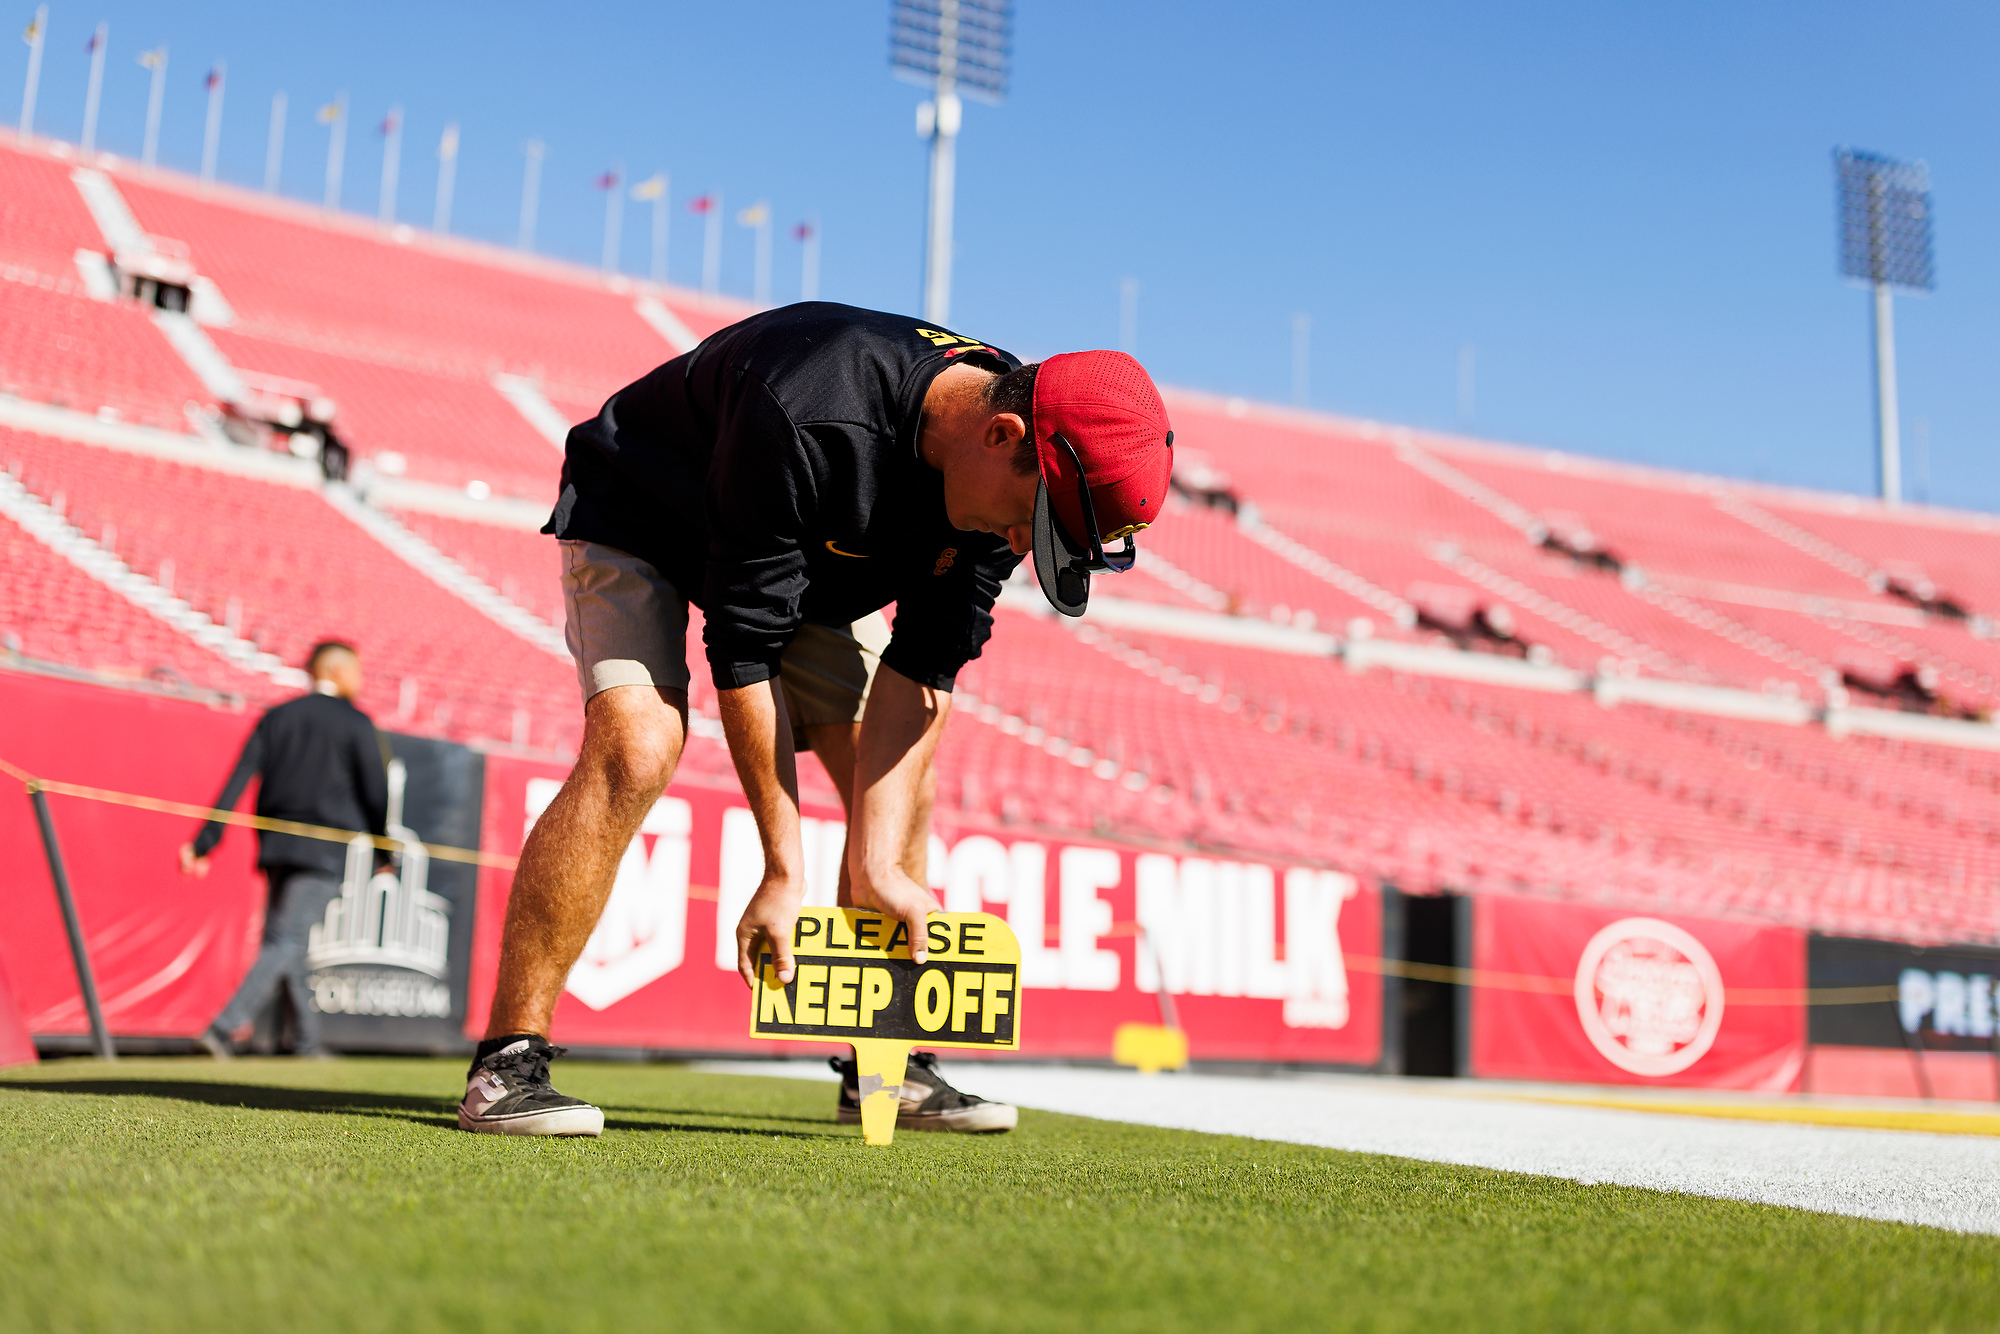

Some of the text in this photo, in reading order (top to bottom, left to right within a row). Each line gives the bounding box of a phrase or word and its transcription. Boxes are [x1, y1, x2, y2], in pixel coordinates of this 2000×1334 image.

[794, 916, 987, 956] PLEASE
[1134, 852, 1350, 1001] MILK
[759, 963, 1014, 1034] KEEP OFF
[1898, 967, 2000, 1038] PRE
